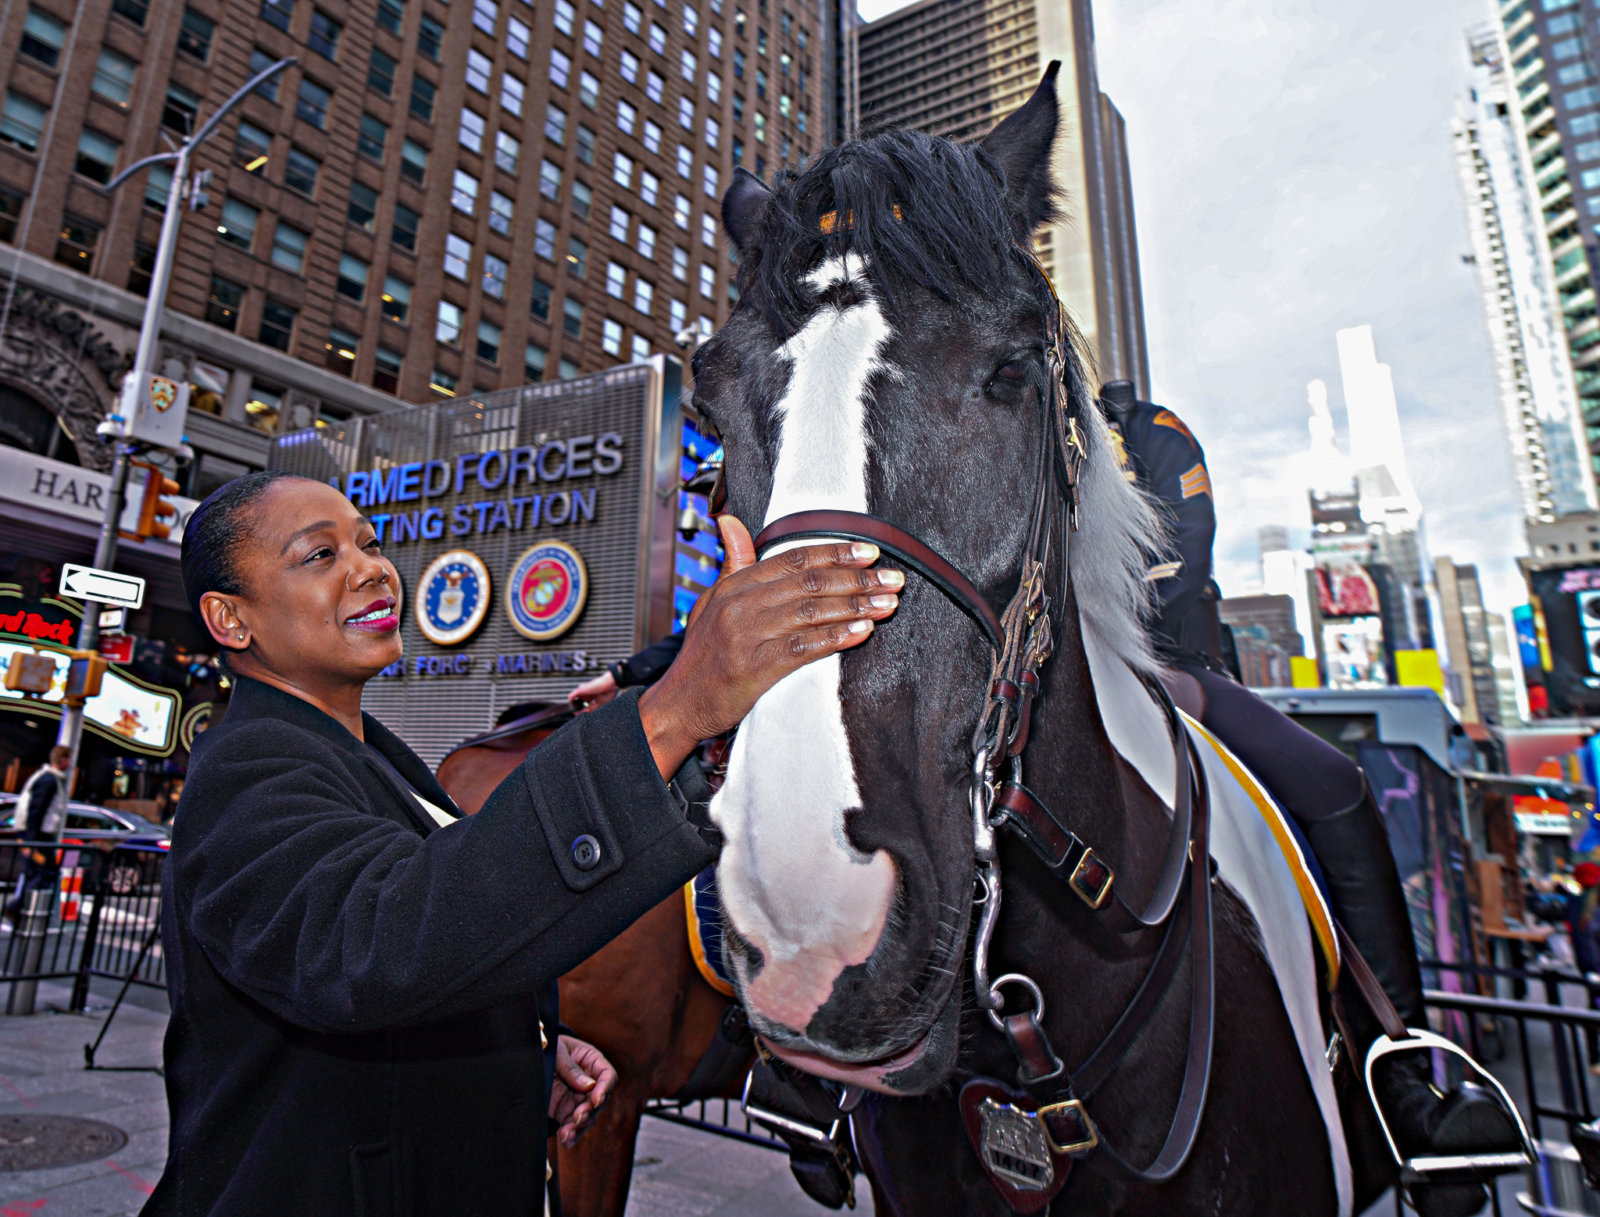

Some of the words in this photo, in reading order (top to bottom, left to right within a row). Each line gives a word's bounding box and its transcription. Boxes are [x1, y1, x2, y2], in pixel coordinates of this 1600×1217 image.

[456, 431, 623, 494] FORCES
[31, 467, 117, 513] HAR
[370, 506, 444, 543] TING
[450, 487, 597, 536] STATION
[416, 653, 475, 676] FORC
[498, 650, 587, 673] MARINES
